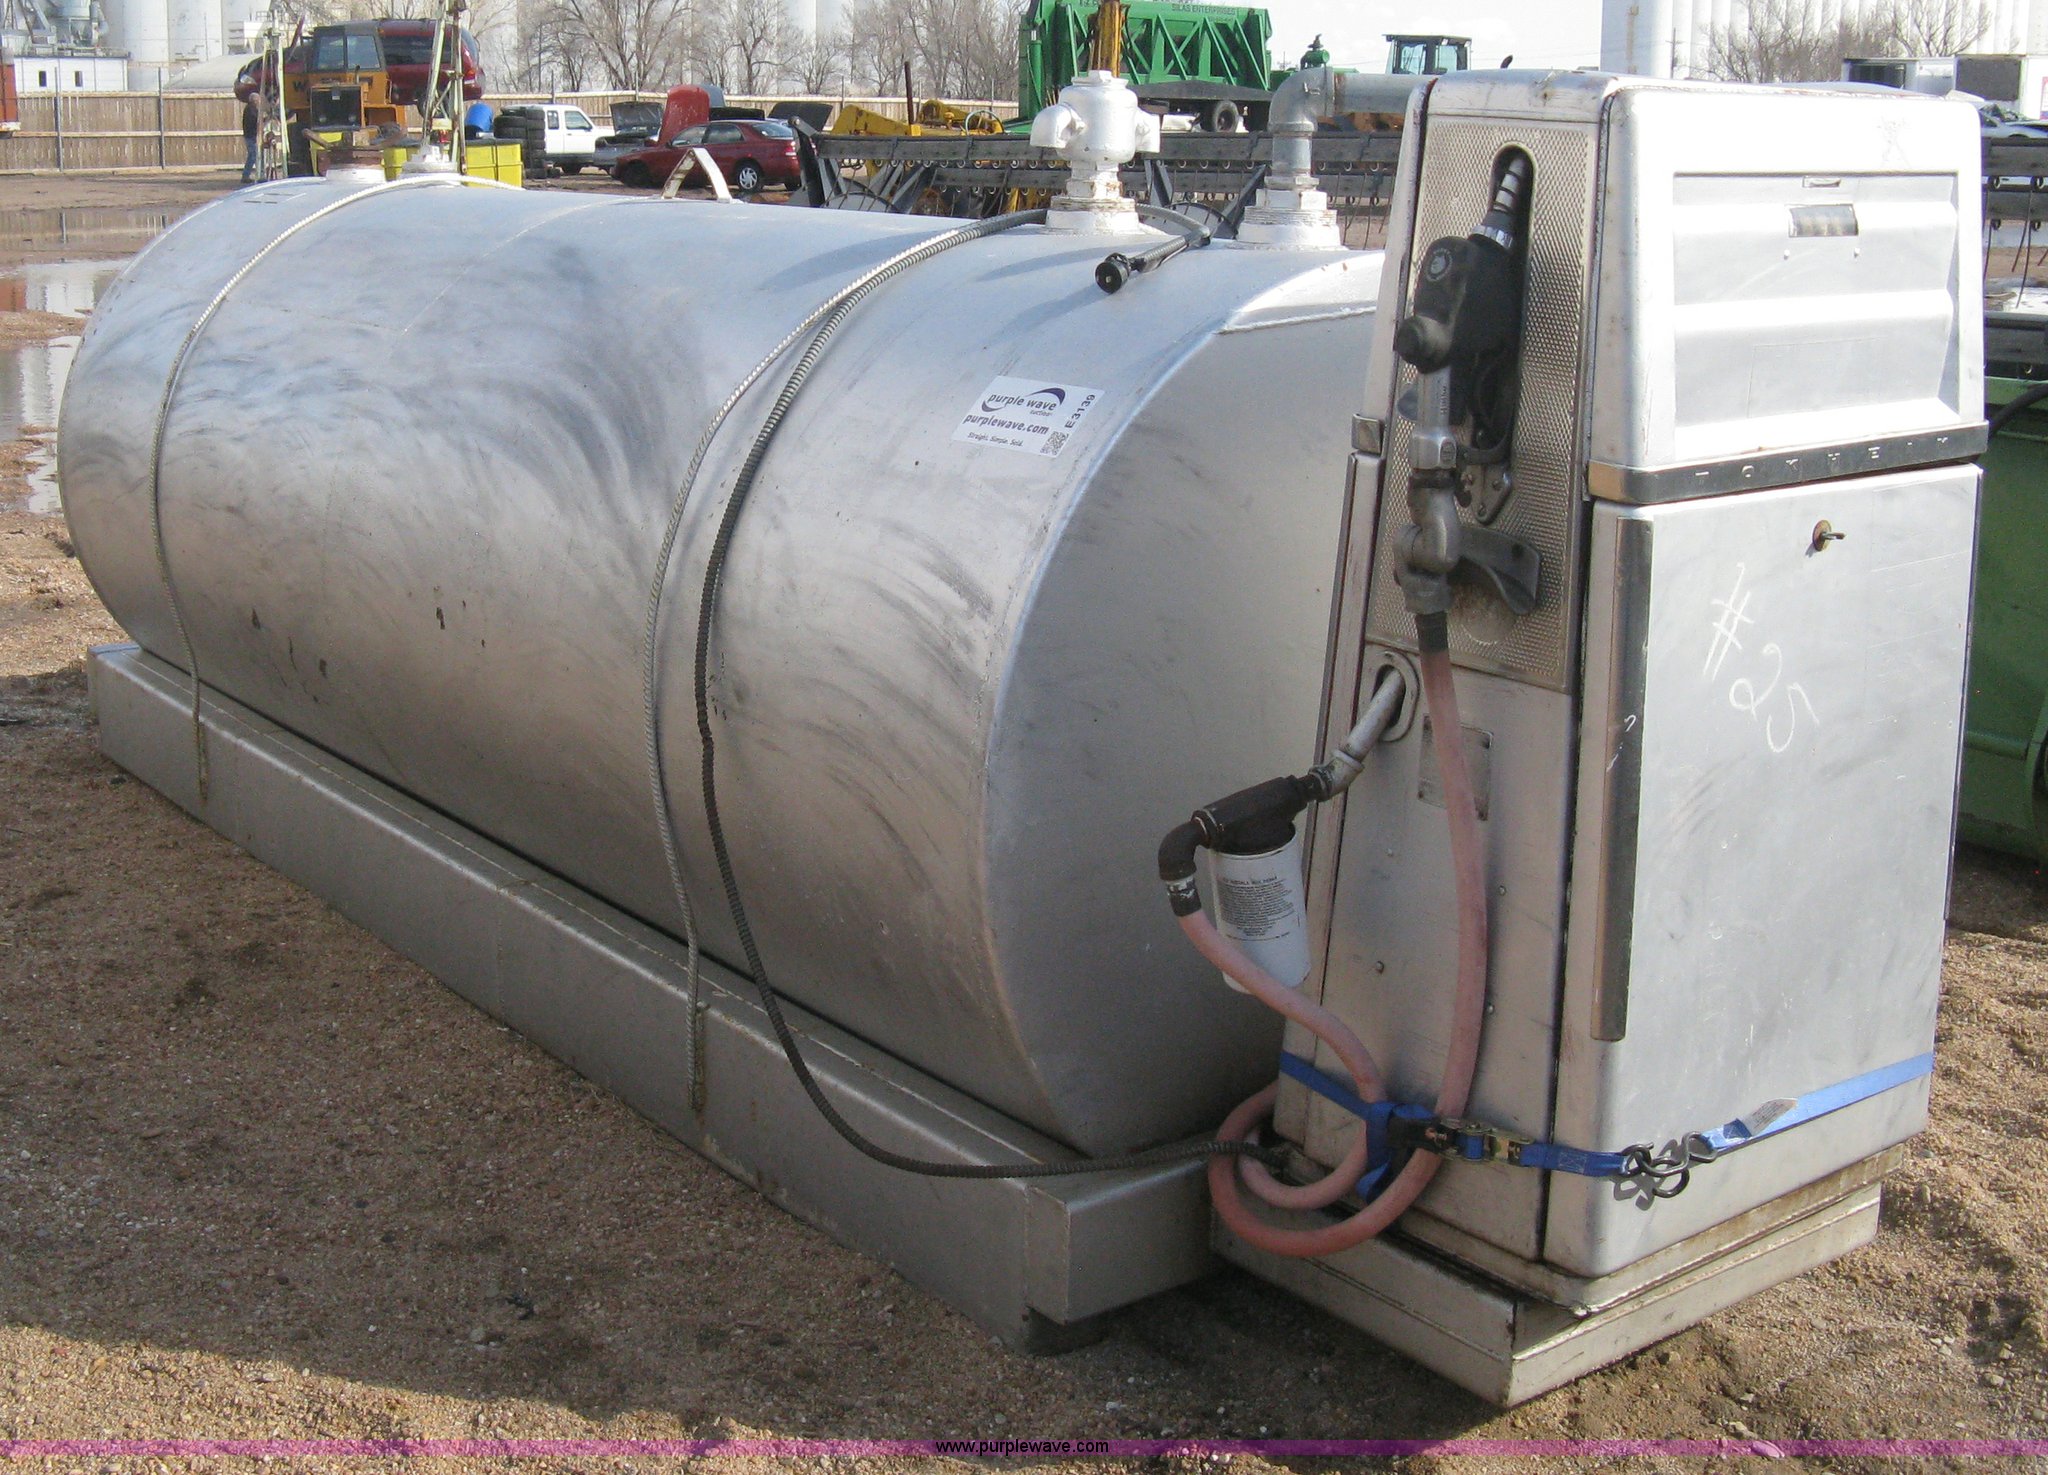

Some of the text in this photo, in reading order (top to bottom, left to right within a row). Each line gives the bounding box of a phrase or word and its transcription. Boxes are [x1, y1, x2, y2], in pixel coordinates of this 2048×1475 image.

[987, 393, 1057, 411] purple wave
[962, 414, 1050, 435] purplewave.com
